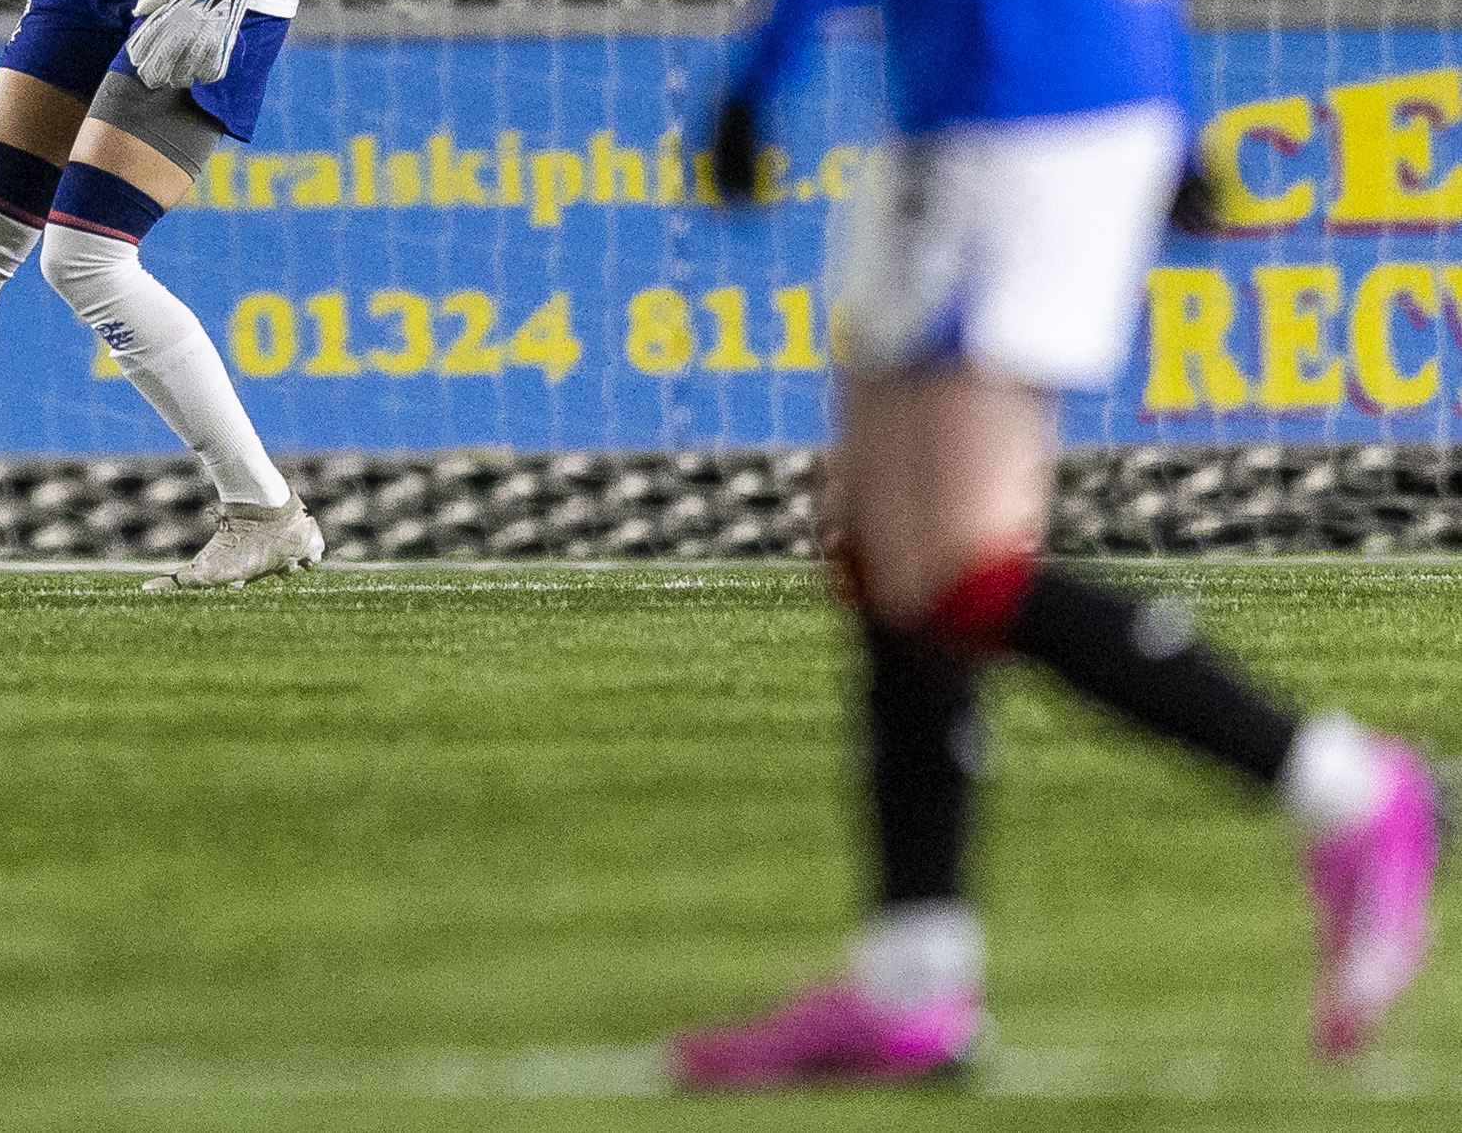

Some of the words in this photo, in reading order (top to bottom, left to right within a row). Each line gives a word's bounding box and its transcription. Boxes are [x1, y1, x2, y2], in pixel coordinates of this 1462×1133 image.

[228, 289, 584, 383] 01324
[626, 285, 854, 375] 811
[1138, 261, 1462, 420] REC
